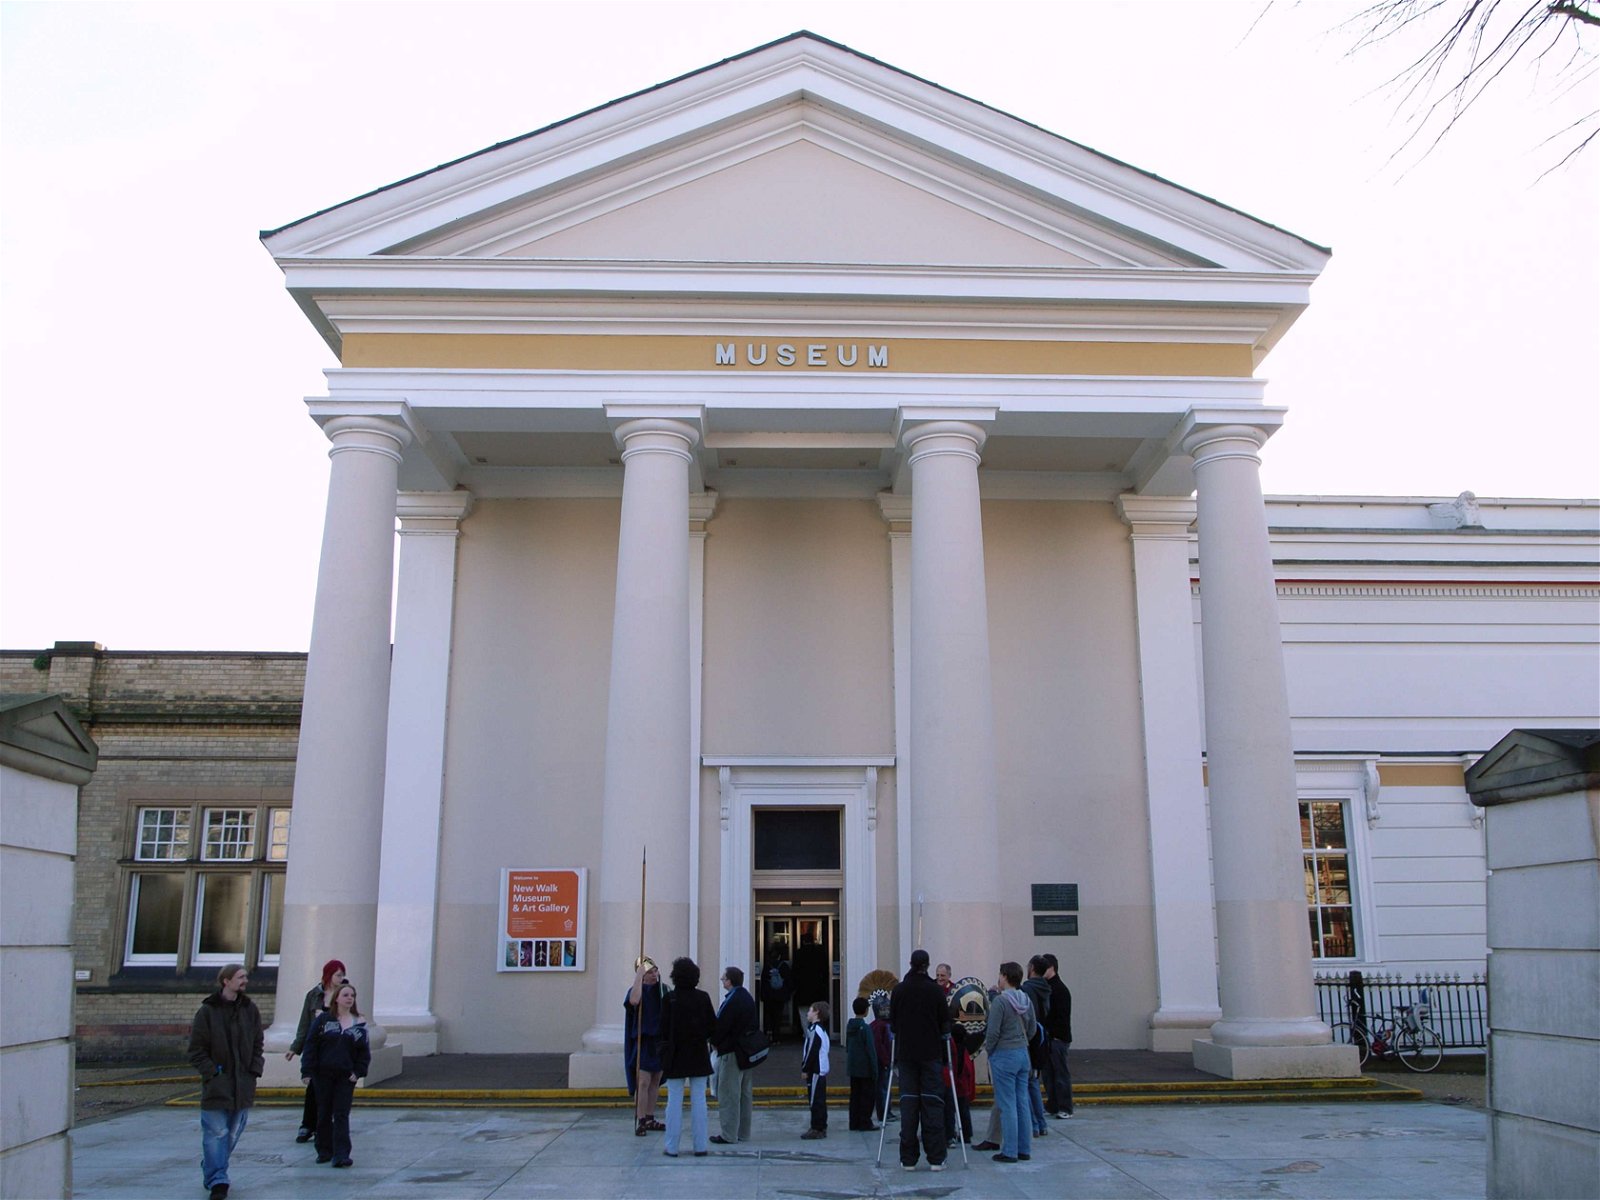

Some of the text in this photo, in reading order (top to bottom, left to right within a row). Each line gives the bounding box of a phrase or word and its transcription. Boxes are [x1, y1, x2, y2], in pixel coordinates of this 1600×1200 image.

[715, 343, 888, 367] MUSEUM
[513, 884, 558, 892] New Walk
[513, 894, 551, 902] Museum
[513, 904, 569, 913] & Art Gallery
